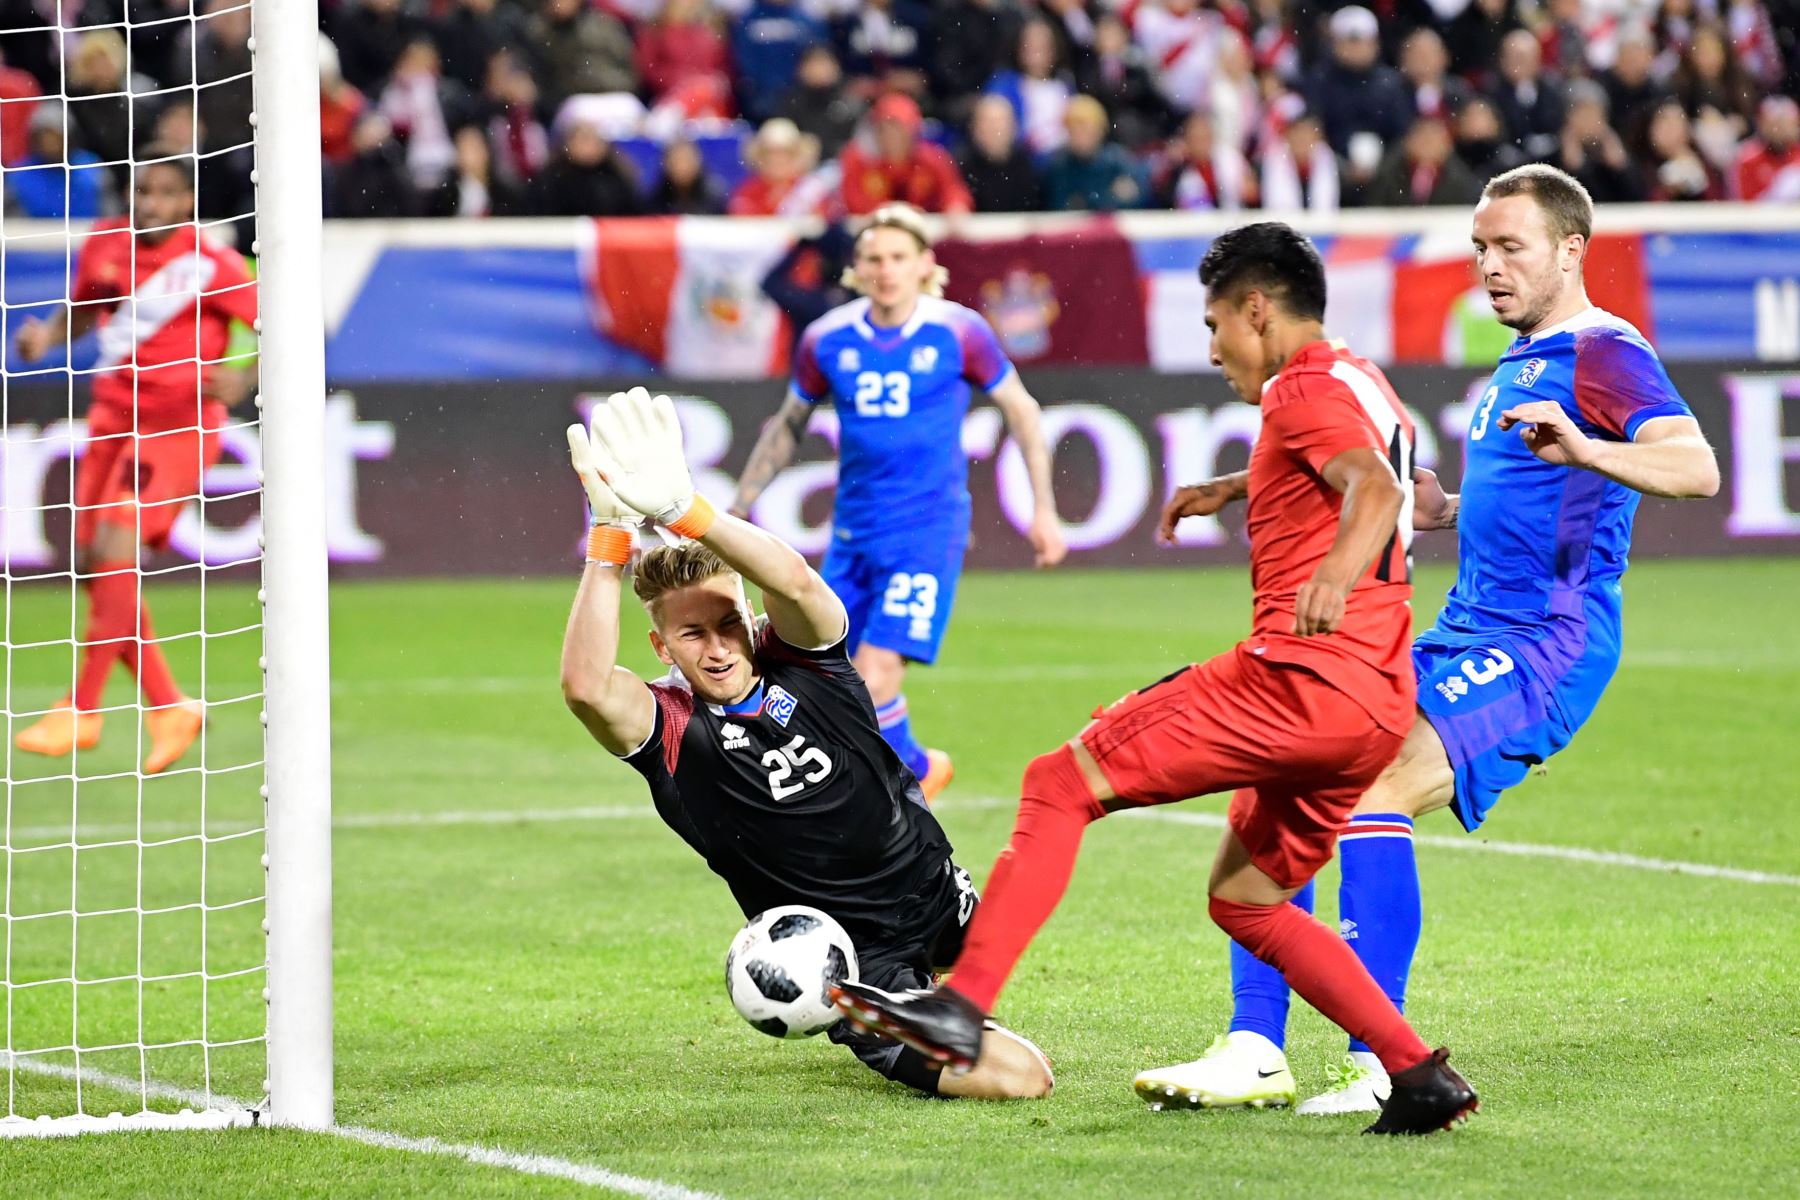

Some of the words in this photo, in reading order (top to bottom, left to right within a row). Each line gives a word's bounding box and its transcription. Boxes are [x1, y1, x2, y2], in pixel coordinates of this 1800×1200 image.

[856, 371, 911, 418] 23
[1471, 385, 1498, 441] 3
[882, 571, 938, 618] 23
[1461, 648, 1514, 685] 3
[760, 734, 832, 801] 25
